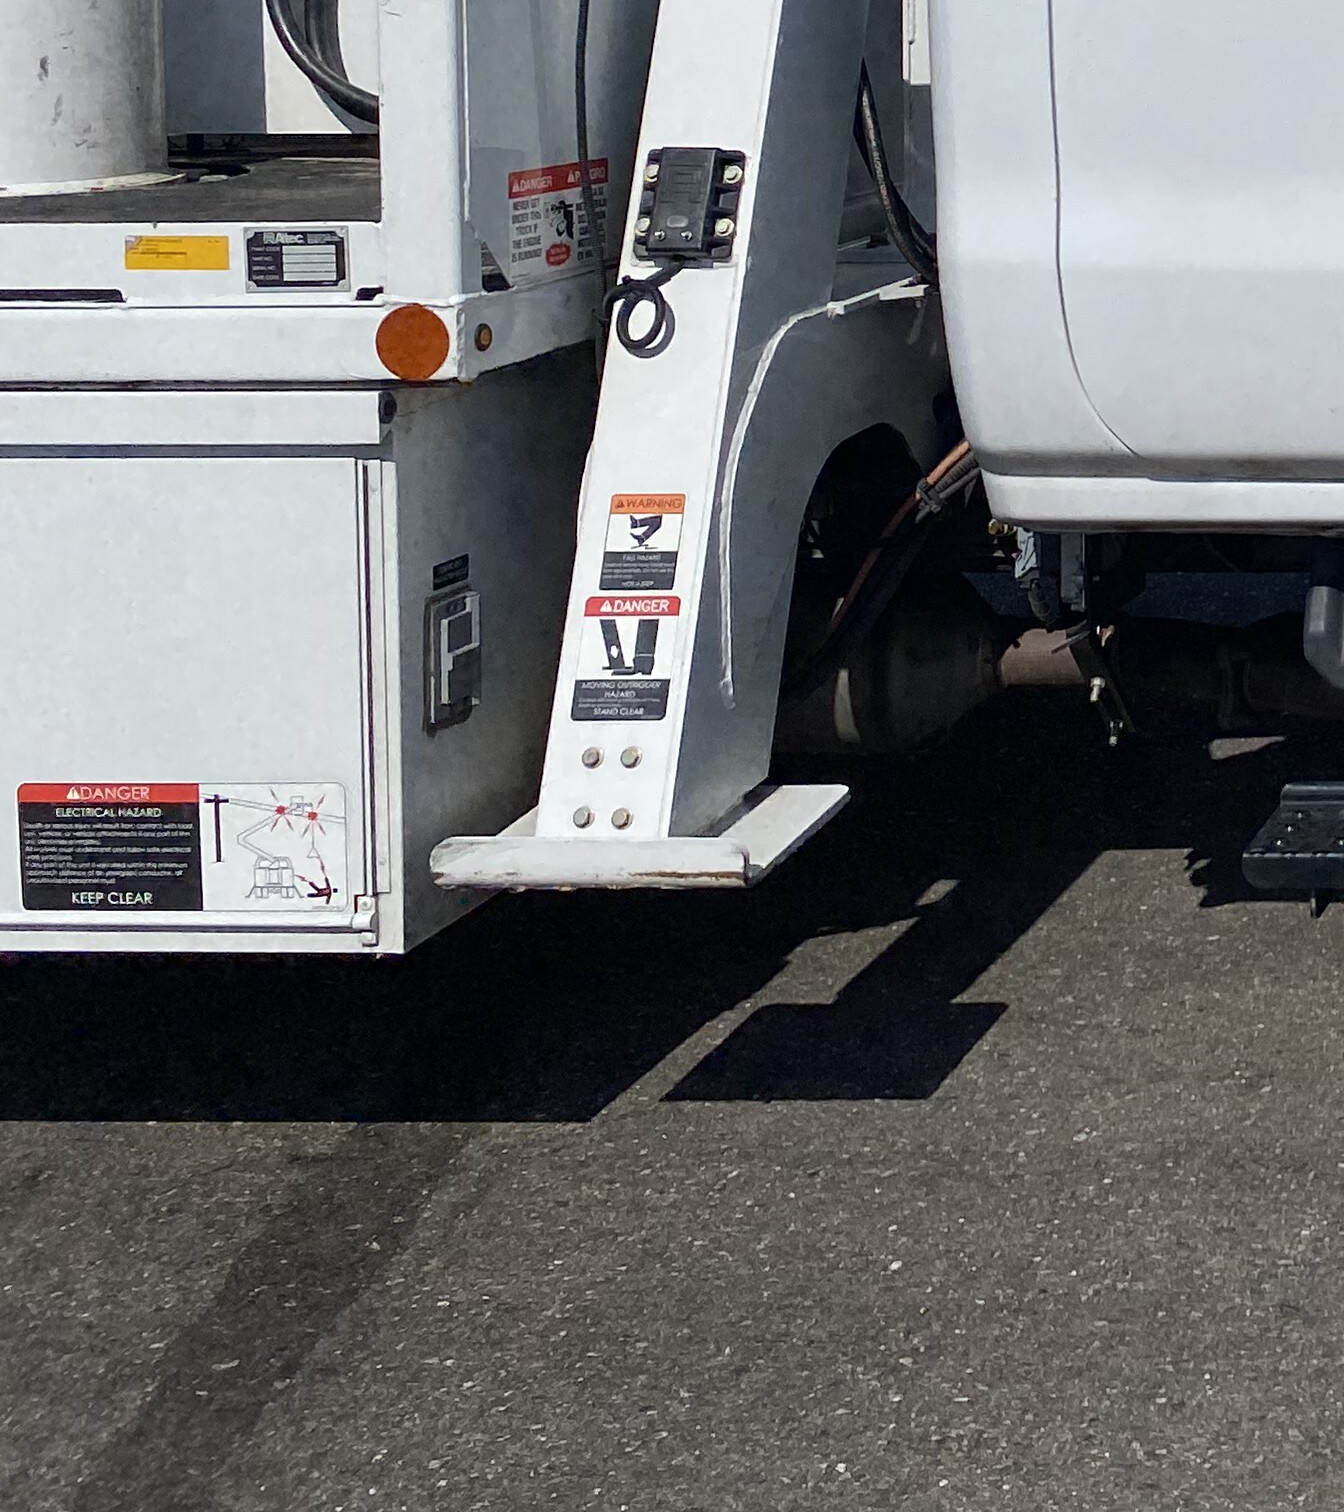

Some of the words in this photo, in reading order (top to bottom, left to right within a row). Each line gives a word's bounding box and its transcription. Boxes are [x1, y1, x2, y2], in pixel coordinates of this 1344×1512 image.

[520, 175, 553, 190] DANGER
[626, 498, 683, 509] WARNING
[613, 599, 670, 613] DANGER
[593, 707, 618, 716] STAND
[619, 707, 645, 716] CLEAR
[79, 785, 150, 800] DANGER
[55, 807, 117, 818] ELECTRICAL
[117, 807, 163, 818] HAZARD
[70, 892, 104, 905] KEEP
[106, 891, 154, 905] CLEAR
